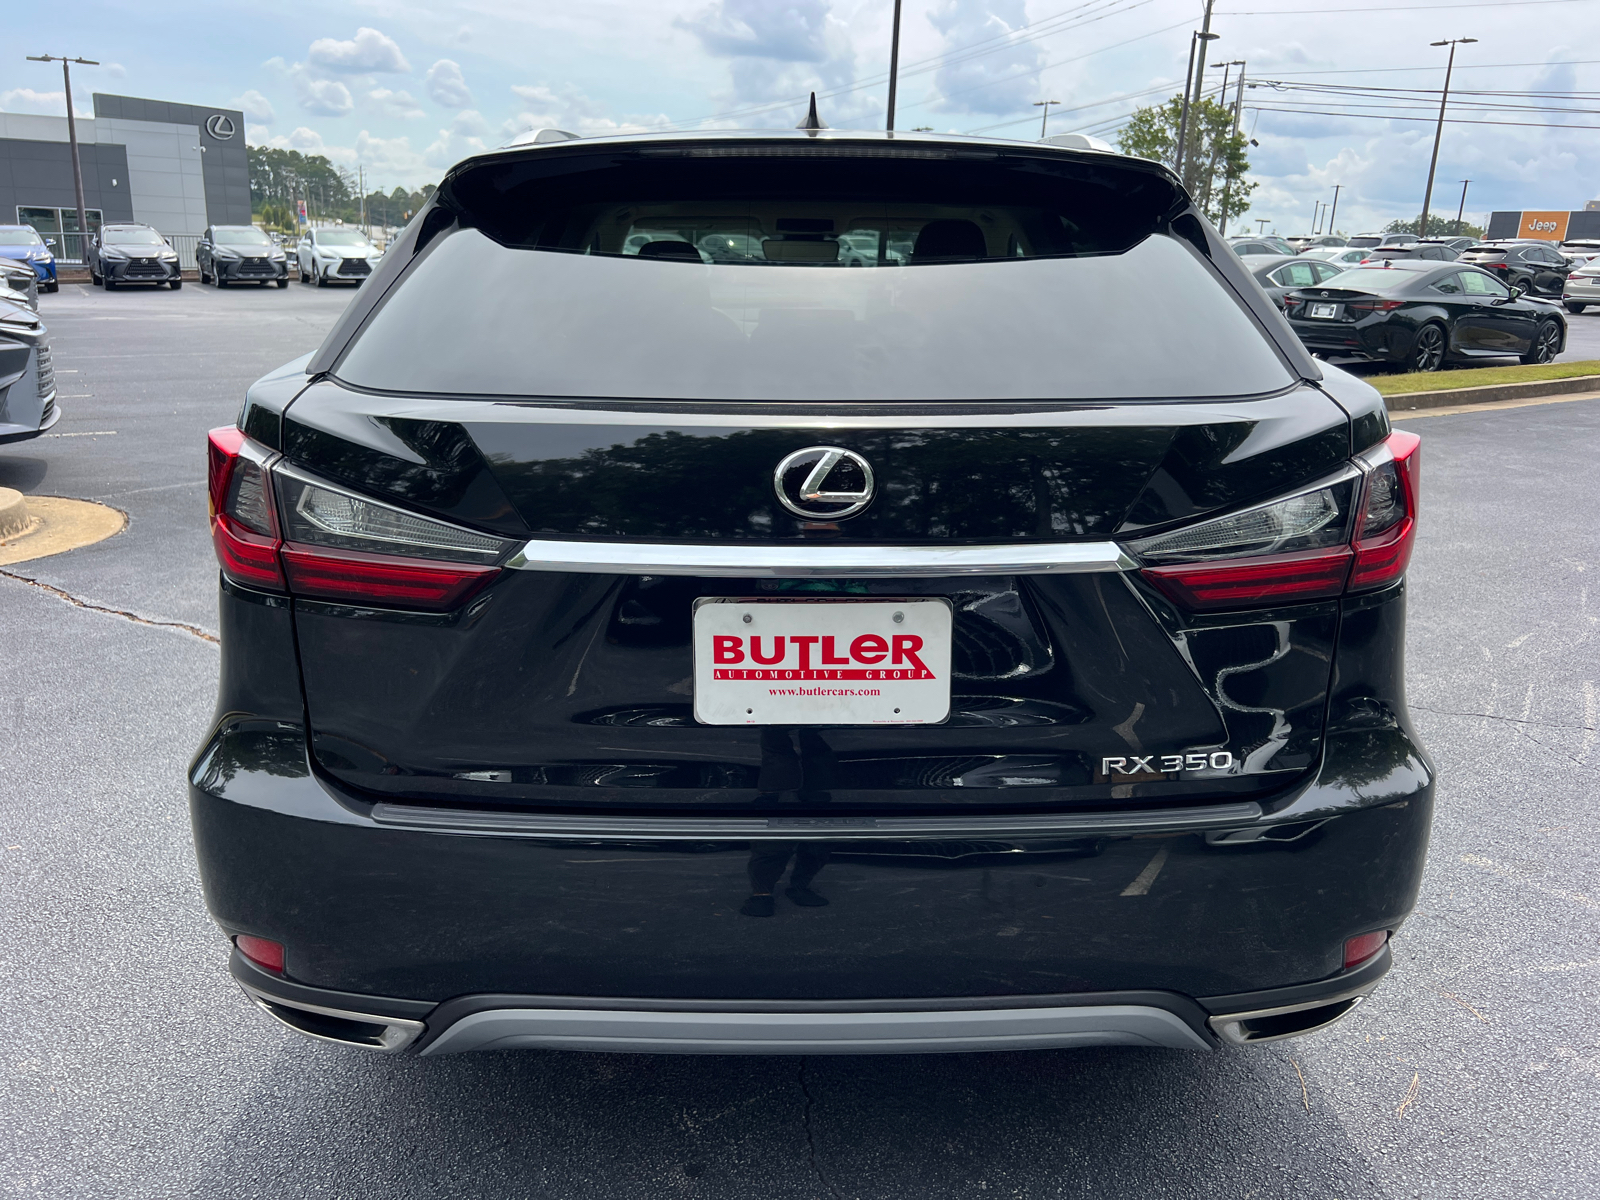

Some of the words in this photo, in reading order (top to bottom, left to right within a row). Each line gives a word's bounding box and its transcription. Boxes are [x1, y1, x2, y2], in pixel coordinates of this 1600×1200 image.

[1528, 218, 1557, 233] Jeep
[715, 670, 843, 679] AUTOMOTIVE
[866, 670, 928, 679] GROUP
[768, 686, 881, 697] www.butlercars.com
[1102, 755, 1156, 775] RX
[1160, 751, 1233, 773] 350
